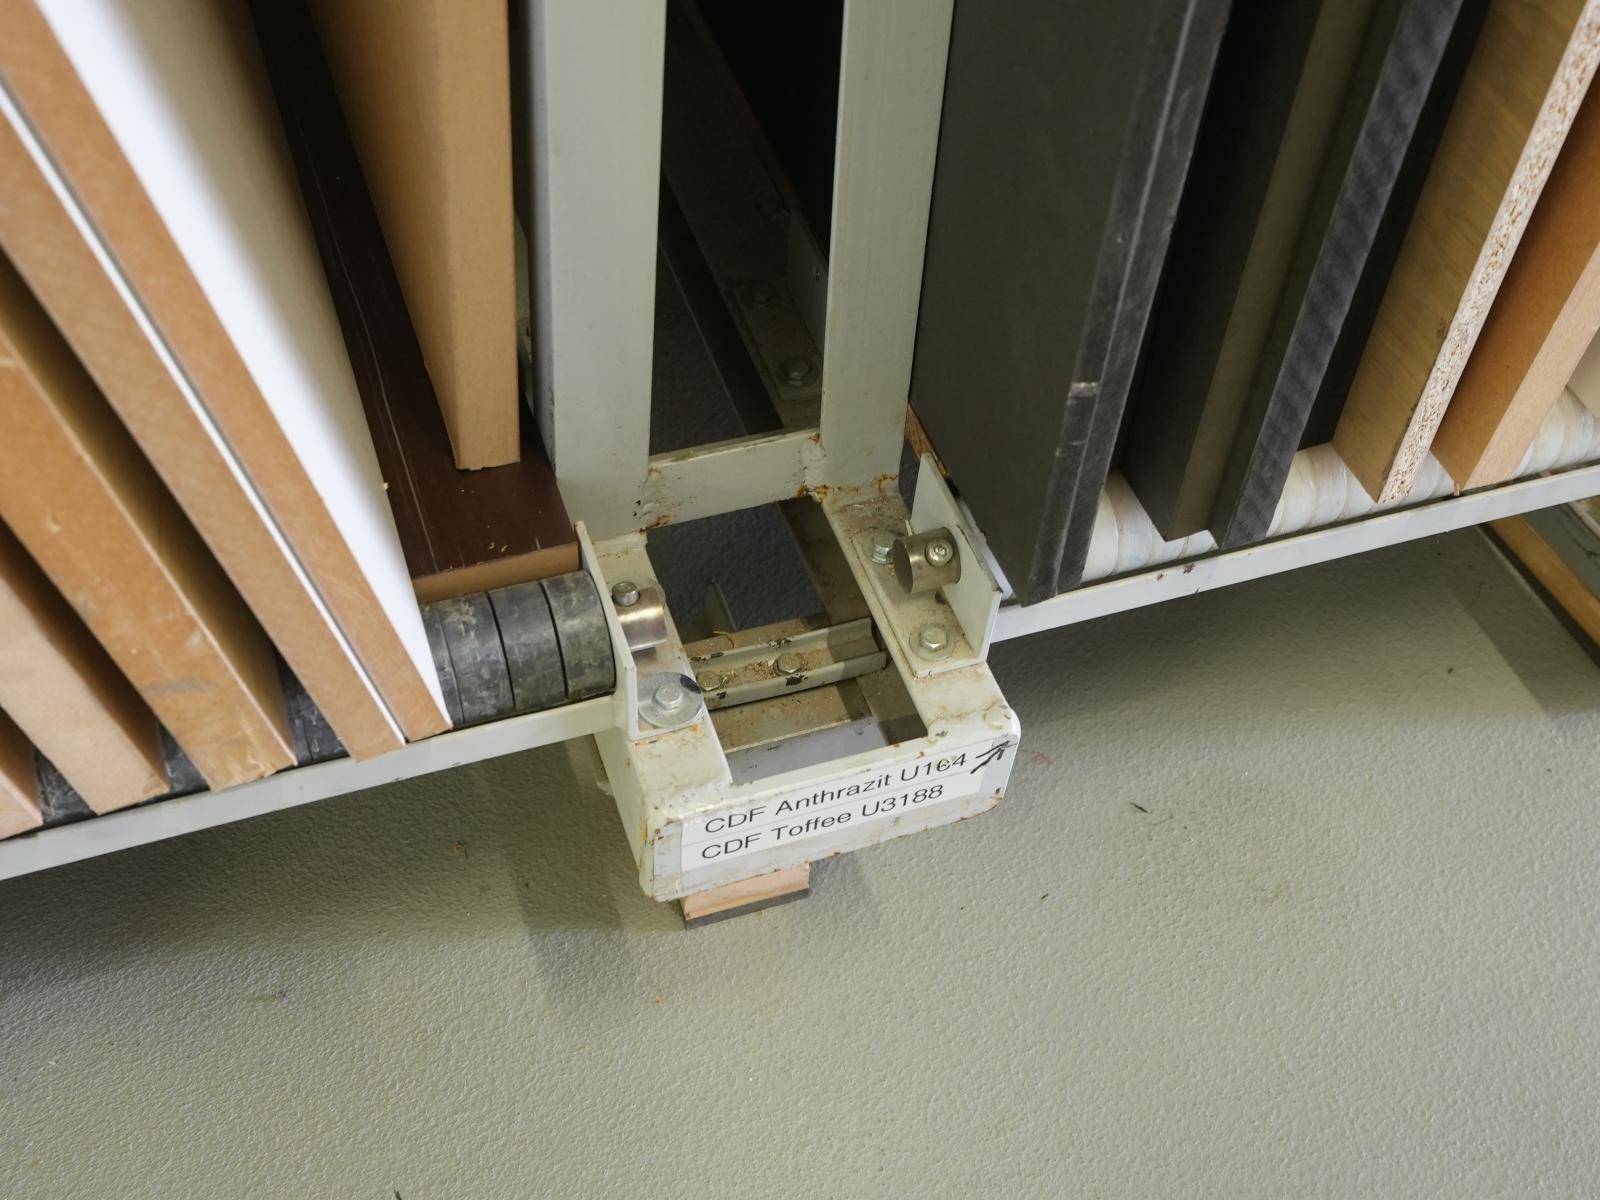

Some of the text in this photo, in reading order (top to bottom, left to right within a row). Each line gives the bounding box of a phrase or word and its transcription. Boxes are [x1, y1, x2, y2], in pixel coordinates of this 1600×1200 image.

[701, 784, 944, 859] CDF Toffee U3188
[704, 806, 766, 834] CDF
[775, 773, 891, 817] Anthrazit
